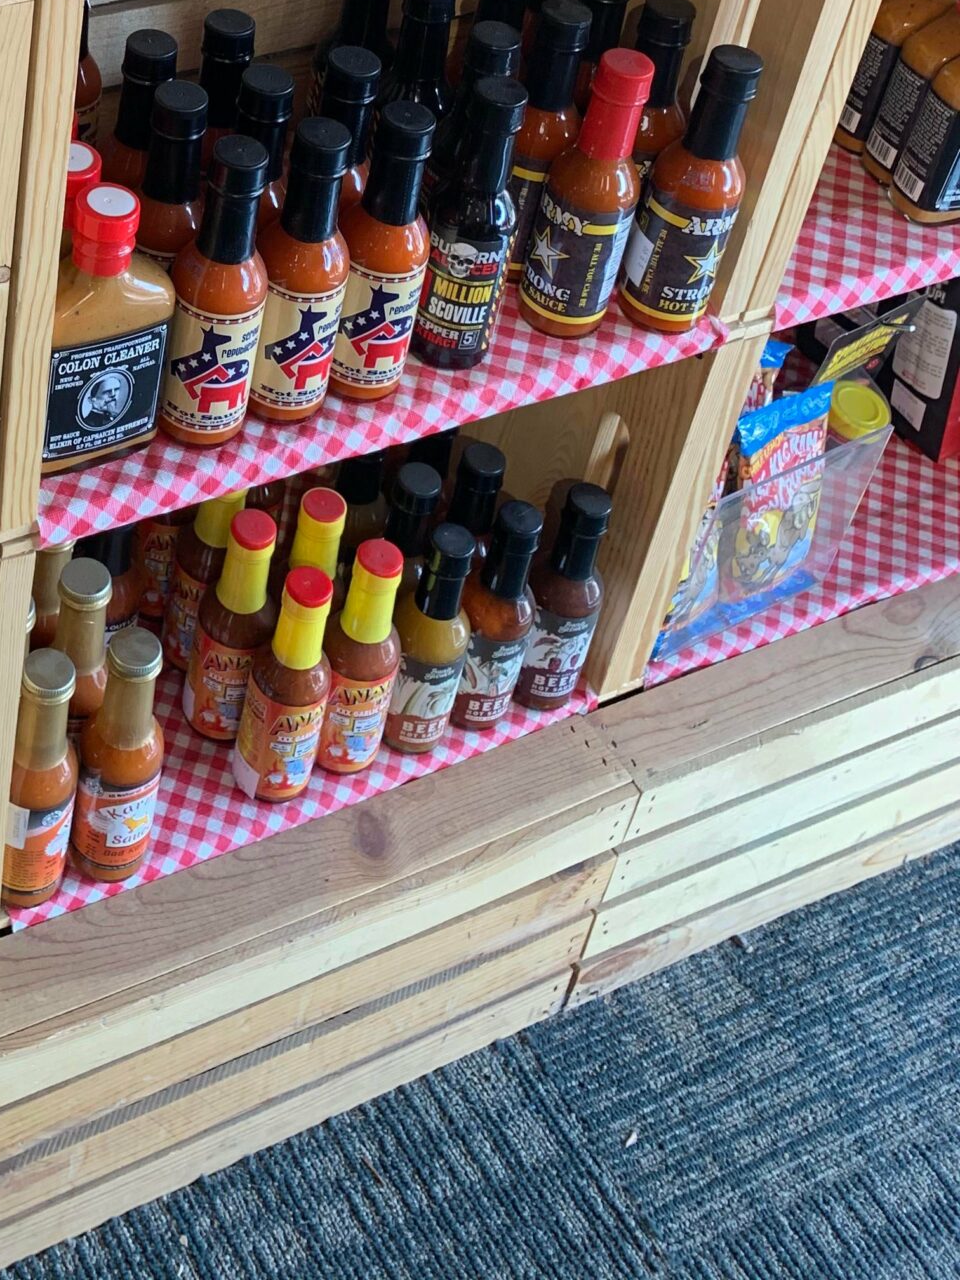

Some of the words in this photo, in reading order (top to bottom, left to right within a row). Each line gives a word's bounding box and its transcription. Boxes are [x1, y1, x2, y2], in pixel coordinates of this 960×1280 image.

[682, 209, 738, 236] ARM
[433, 276, 494, 304] MILLION
[528, 288, 568, 312] SAUCE
[658, 299, 689, 312] HOT
[428, 296, 488, 324] SCOVILLE
[418, 316, 459, 340] EPPER
[463, 332, 472, 344] 5
[58, 356, 101, 375] COLON
[104, 338, 159, 365] CLEANER
[71, 349, 103, 360] PROFESSOR
[132, 360, 155, 371] NATURAL
[55, 380, 84, 390] IMPROVED
[49, 440, 72, 449] ELIXIR
